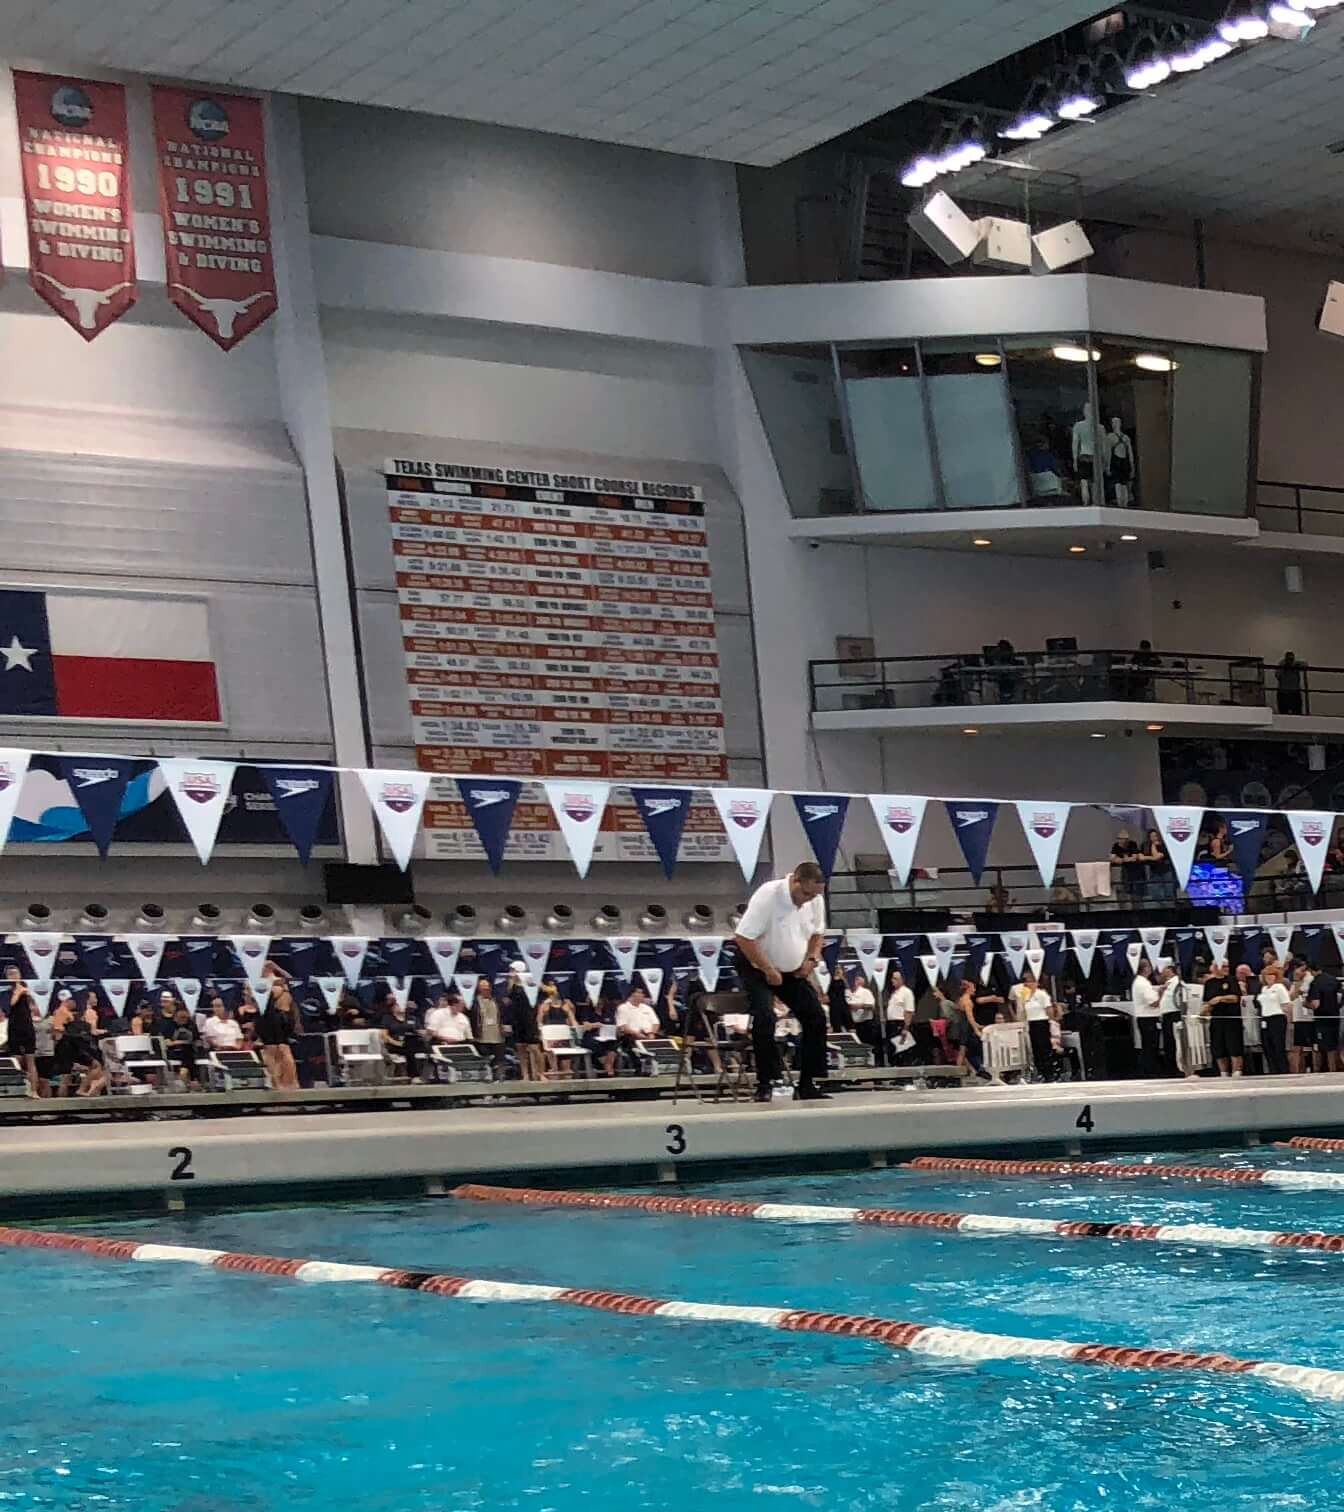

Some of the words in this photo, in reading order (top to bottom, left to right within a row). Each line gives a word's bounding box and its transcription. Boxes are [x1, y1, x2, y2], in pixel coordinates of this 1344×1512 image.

[167, 141, 254, 161] NATIONAL
[38, 163, 118, 197] 1990
[176, 177, 252, 209] 1991
[33, 199, 121, 222] WOMEN'S
[32, 219, 130, 242] SWIMMING
[172, 212, 260, 234] WOMEN'S
[57, 242, 124, 263] DIVING
[167, 231, 267, 253] SWIMMING
[196, 253, 262, 272] DIVING
[393, 460, 433, 477] TEXAS
[434, 463, 504, 482] SWIMMING
[506, 469, 551, 487] CENTER
[553, 473, 591, 491] SHORT
[594, 477, 640, 495] COURSE
[1076, 1104, 1095, 1132] 4
[666, 1124, 686, 1154] 3
[167, 1146, 195, 1180] 2
